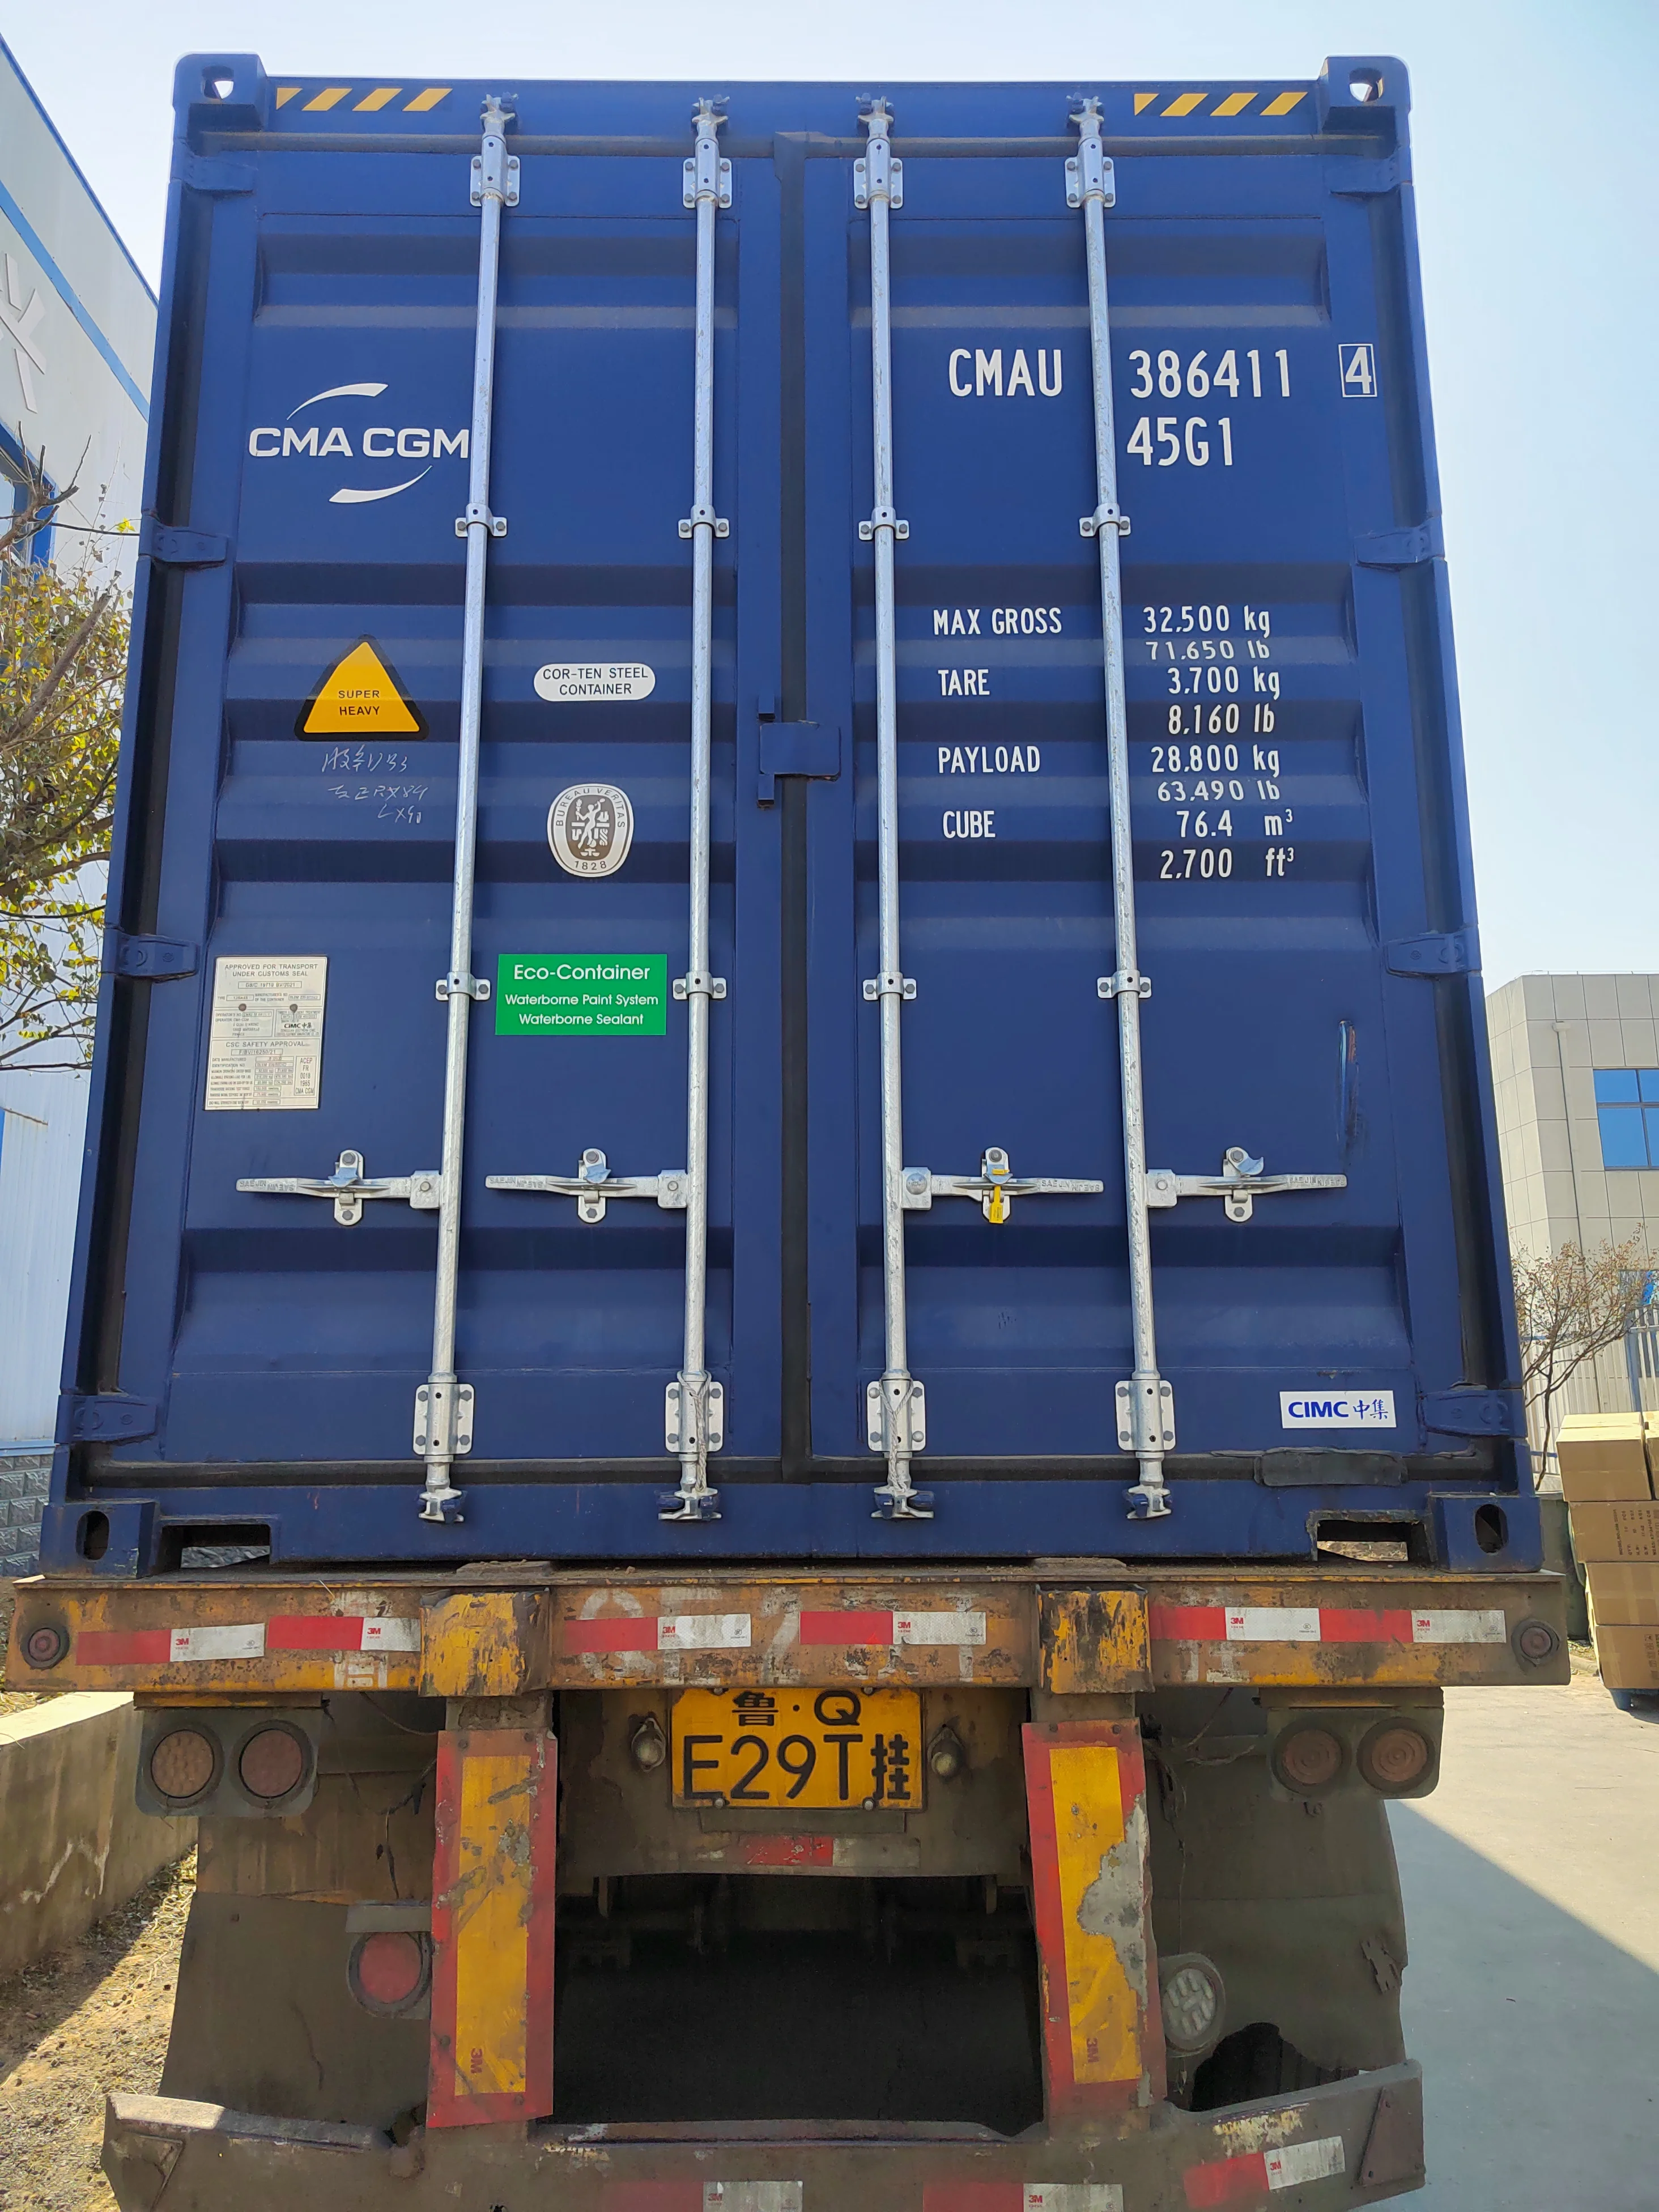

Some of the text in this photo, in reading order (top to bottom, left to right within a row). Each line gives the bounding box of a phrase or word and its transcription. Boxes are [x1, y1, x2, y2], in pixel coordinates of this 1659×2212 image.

[948, 347, 1372, 398] CMAU 386411 4
[249, 427, 469, 458] CMA CGM
[1126, 416, 1233, 466] 45G1
[933, 607, 1062, 635] MAX GROSS
[1143, 605, 1270, 639] 32,500 kg
[1146, 640, 1270, 660] 71,650 lb
[543, 667, 648, 679] COR-TEN STEEL
[938, 669, 990, 696] TARE
[1167, 665, 1280, 700] 3,700 kg
[338, 690, 380, 699] SUPER
[559, 683, 632, 695] CONTAINER
[339, 706, 380, 715] HEAVY
[1168, 703, 1274, 735] 8,160 lb
[938, 746, 1040, 773] PAYLOAD
[1151, 744, 1279, 777] 28,800 kg
[1158, 780, 1280, 801] 63,490 lb
[556, 788, 626, 827] BUREAU VERITAS
[943, 810, 996, 838] CUBE
[1176, 810, 1232, 837] 76.4
[575, 861, 606, 870] 1828
[1160, 848, 1232, 879] 2,700
[514, 964, 650, 980] Eco-Container
[505, 994, 658, 1007] Waterborne Paint System
[519, 1014, 644, 1025] Waterborne Sealant
[1288, 1399, 1388, 1420] CIMC 中集
[471, 2048, 483, 2073] 3M
[1270, 2160, 1281, 2171] 3M
